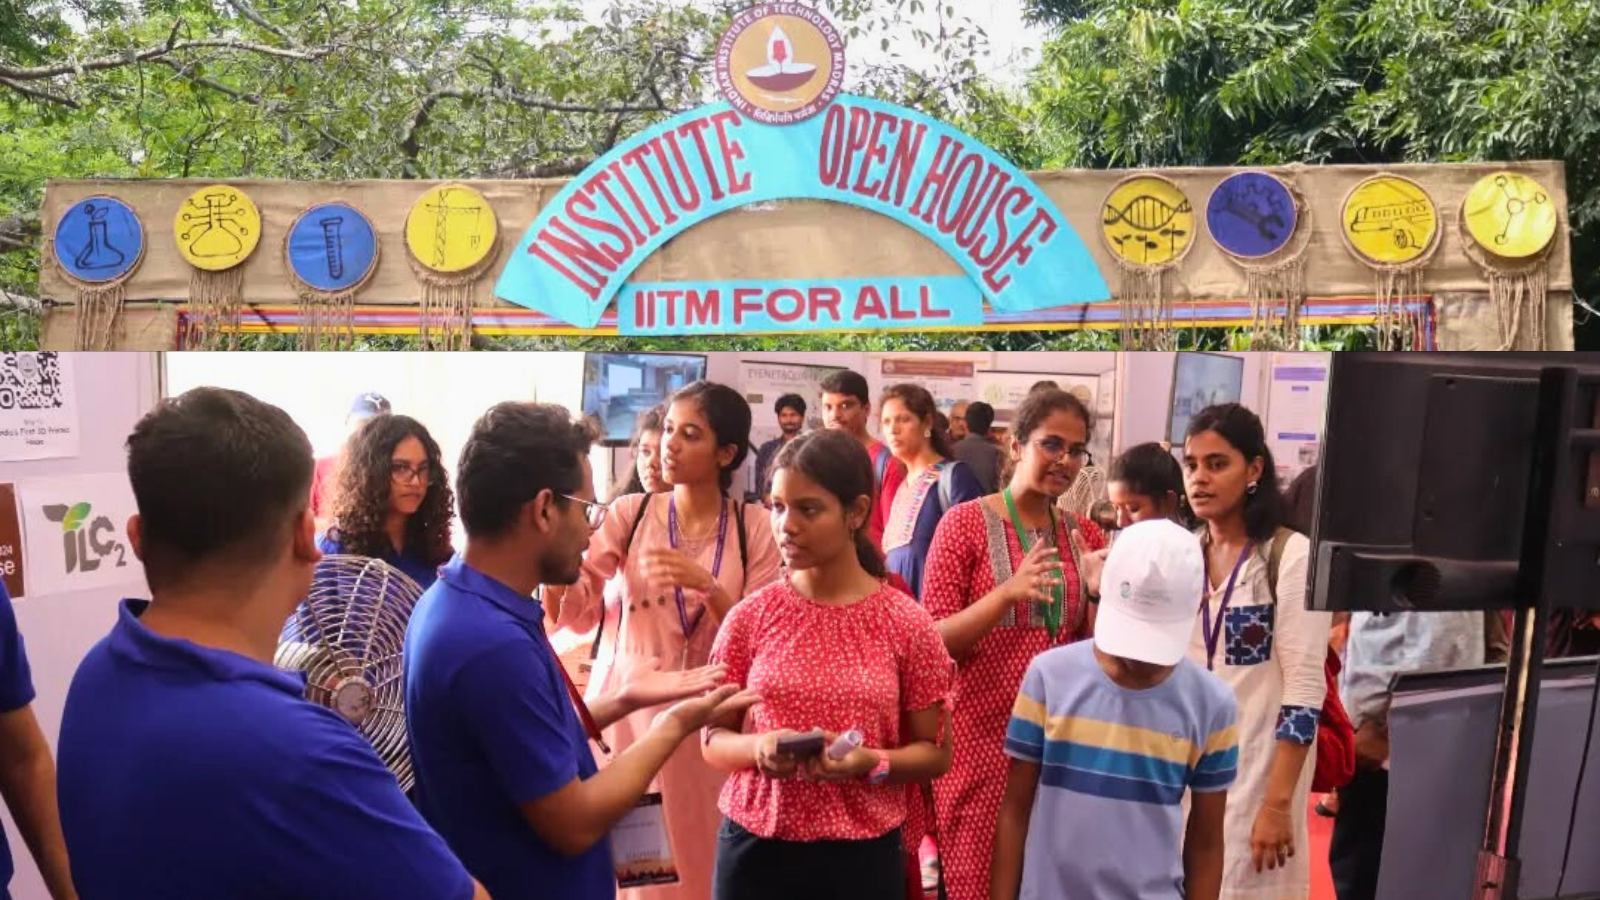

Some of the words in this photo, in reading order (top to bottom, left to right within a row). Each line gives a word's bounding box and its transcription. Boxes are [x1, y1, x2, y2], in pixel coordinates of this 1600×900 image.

[754, 7, 769, 17] OF
[774, 3, 842, 49] TECHNOLOGY
[718, 17, 753, 68] INSTITUTE
[719, 69, 747, 110] INDIAN
[821, 52, 843, 101] MADRAS
[527, 109, 752, 300] INSTITUTE
[818, 103, 929, 208] OPEN
[921, 134, 1058, 294] HOUSE
[634, 290, 719, 328] IITM
[733, 286, 841, 324] FOR
[853, 284, 950, 320] ALL
